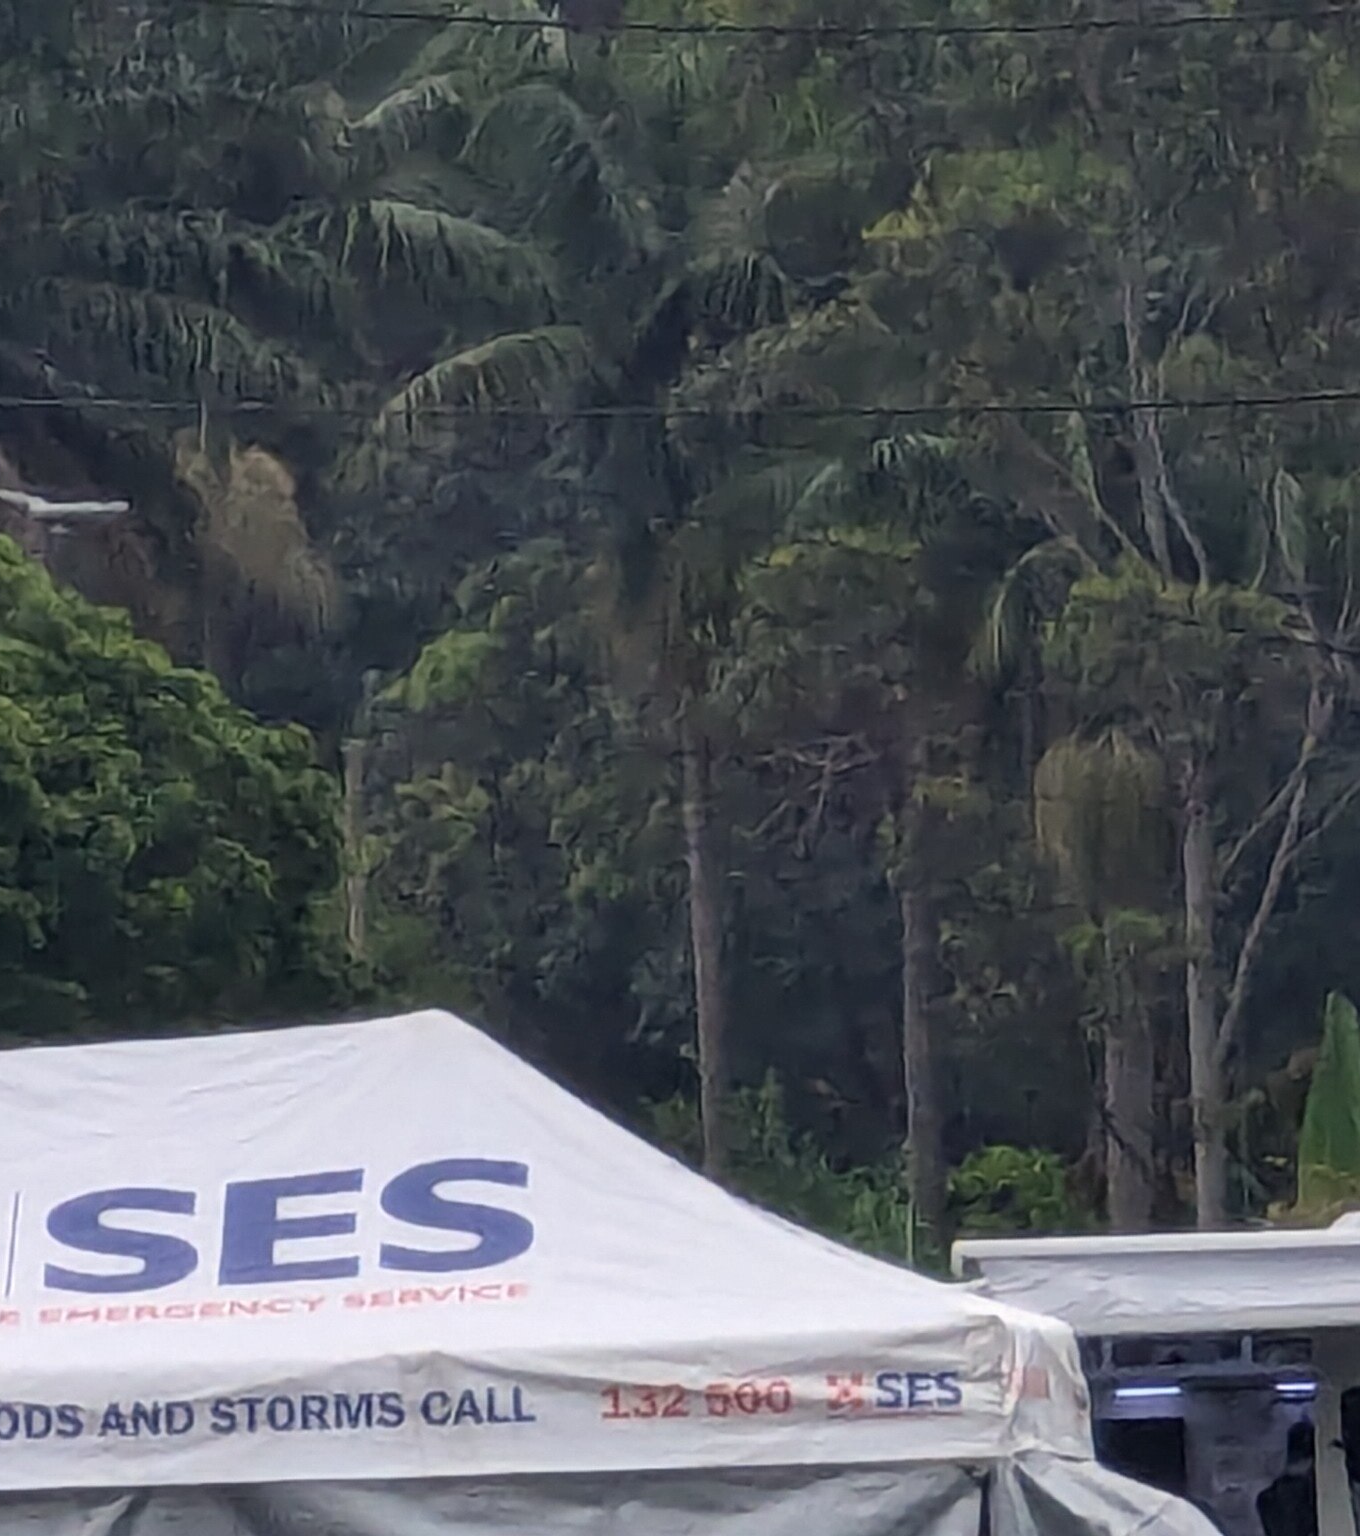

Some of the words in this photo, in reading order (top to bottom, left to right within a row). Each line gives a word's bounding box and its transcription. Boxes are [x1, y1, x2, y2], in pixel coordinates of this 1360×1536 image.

[43, 1157, 535, 1294] SES
[39, 1296, 327, 1324] EMERGENCY
[342, 1283, 530, 1309] SERVICE
[98, 1401, 195, 1438] AND
[209, 1391, 407, 1435] STORMS
[419, 1385, 538, 1427] CALL
[600, 1382, 691, 1419] 132
[706, 1380, 793, 1417] 500
[875, 1370, 963, 1408] SES
